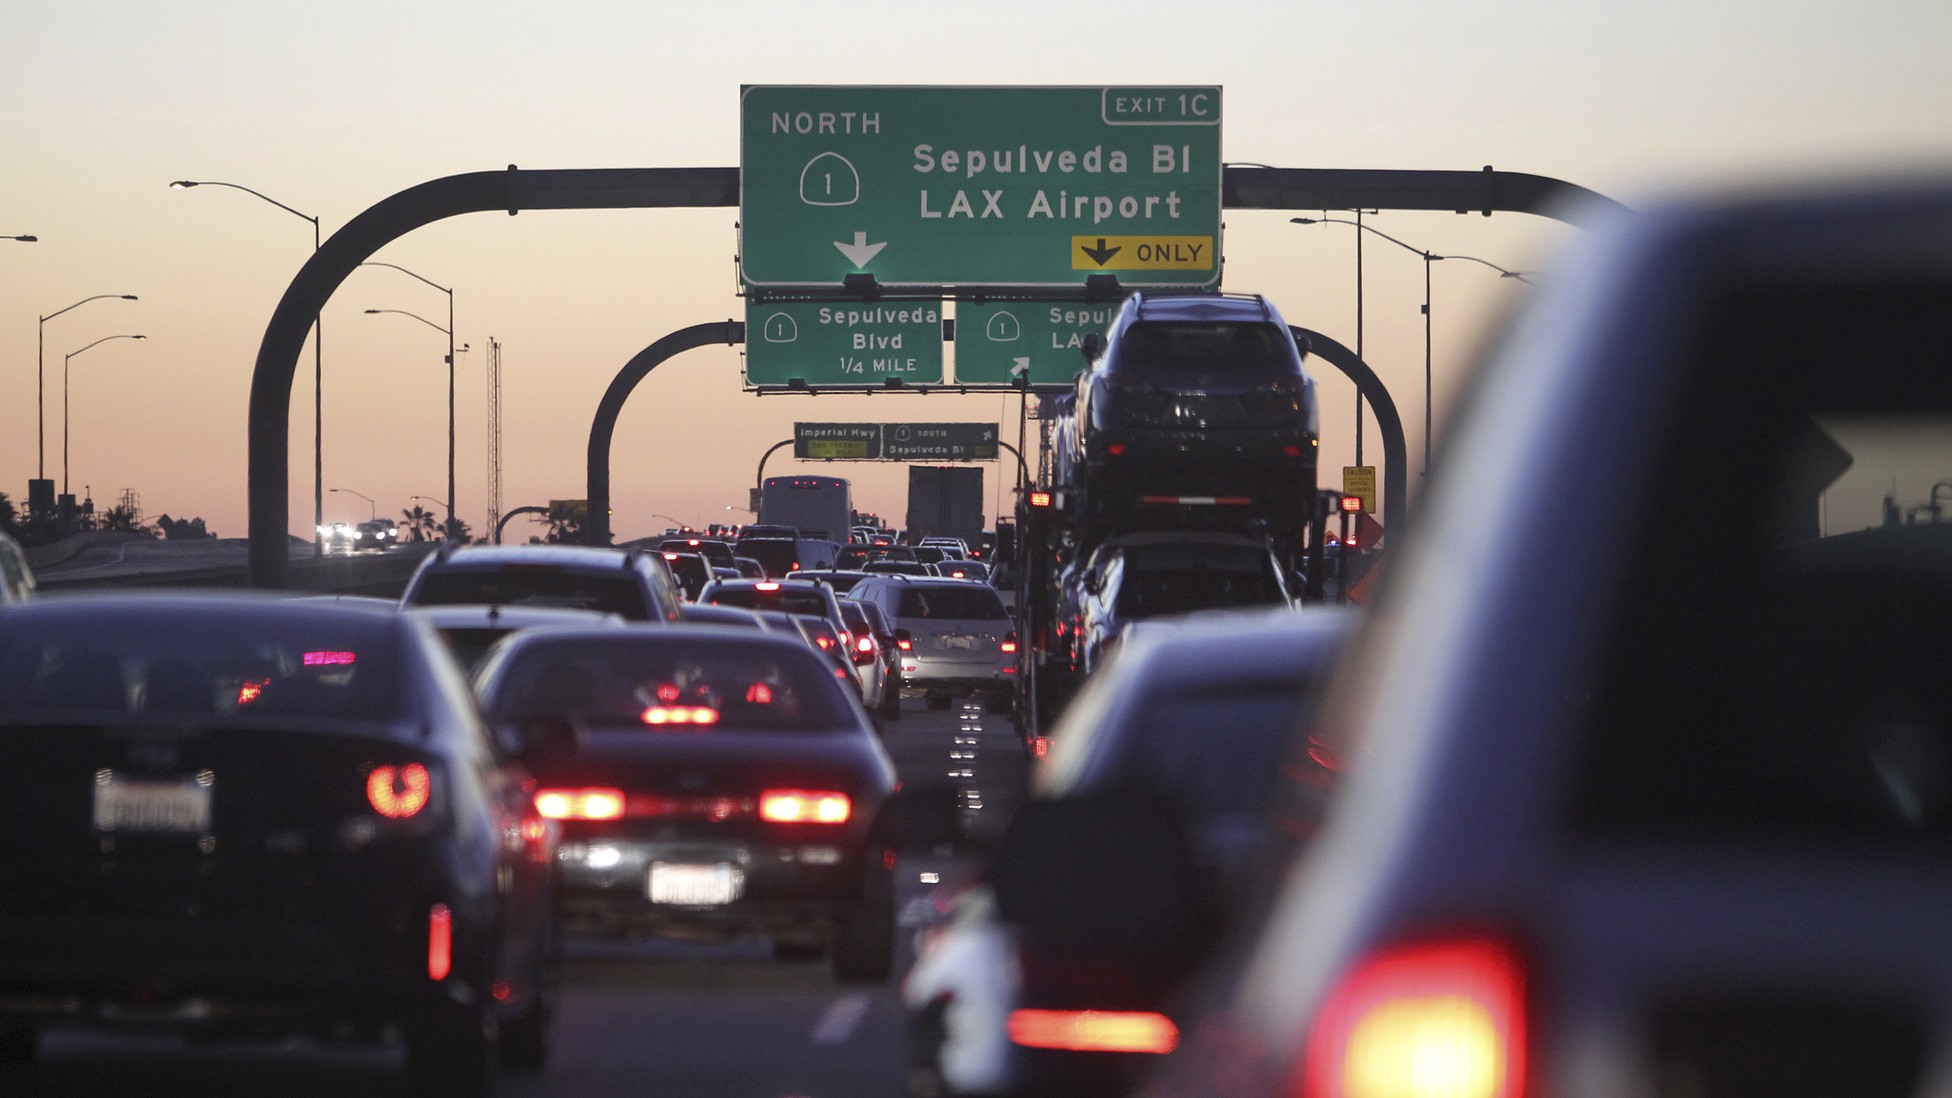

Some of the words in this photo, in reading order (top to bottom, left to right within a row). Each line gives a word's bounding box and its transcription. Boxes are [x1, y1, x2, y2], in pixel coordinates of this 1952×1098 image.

[1116, 98, 1165, 113] EXIT
[1179, 94, 1208, 116] 1C
[771, 112, 881, 134] NORTH
[913, 144, 1128, 179] Sepulveda
[824, 173, 831, 195] 1
[920, 190, 1004, 218] LAX
[1027, 190, 1181, 224] Airport
[1137, 244, 1203, 263] ONLY
[819, 307, 938, 327] Sepulveda
[1050, 307, 1112, 327] Sepul
[777, 324, 783, 337] 1
[1000, 322, 1005, 335] 1
[853, 333, 903, 350] Blvd
[1052, 332, 1082, 348] LA
[839, 357, 864, 374] 1/4
[873, 358, 917, 372] MILE
[800, 427, 847, 438] Imperial
[851, 428, 876, 440] Hwy
[889, 445, 948, 454] Sepulveda
